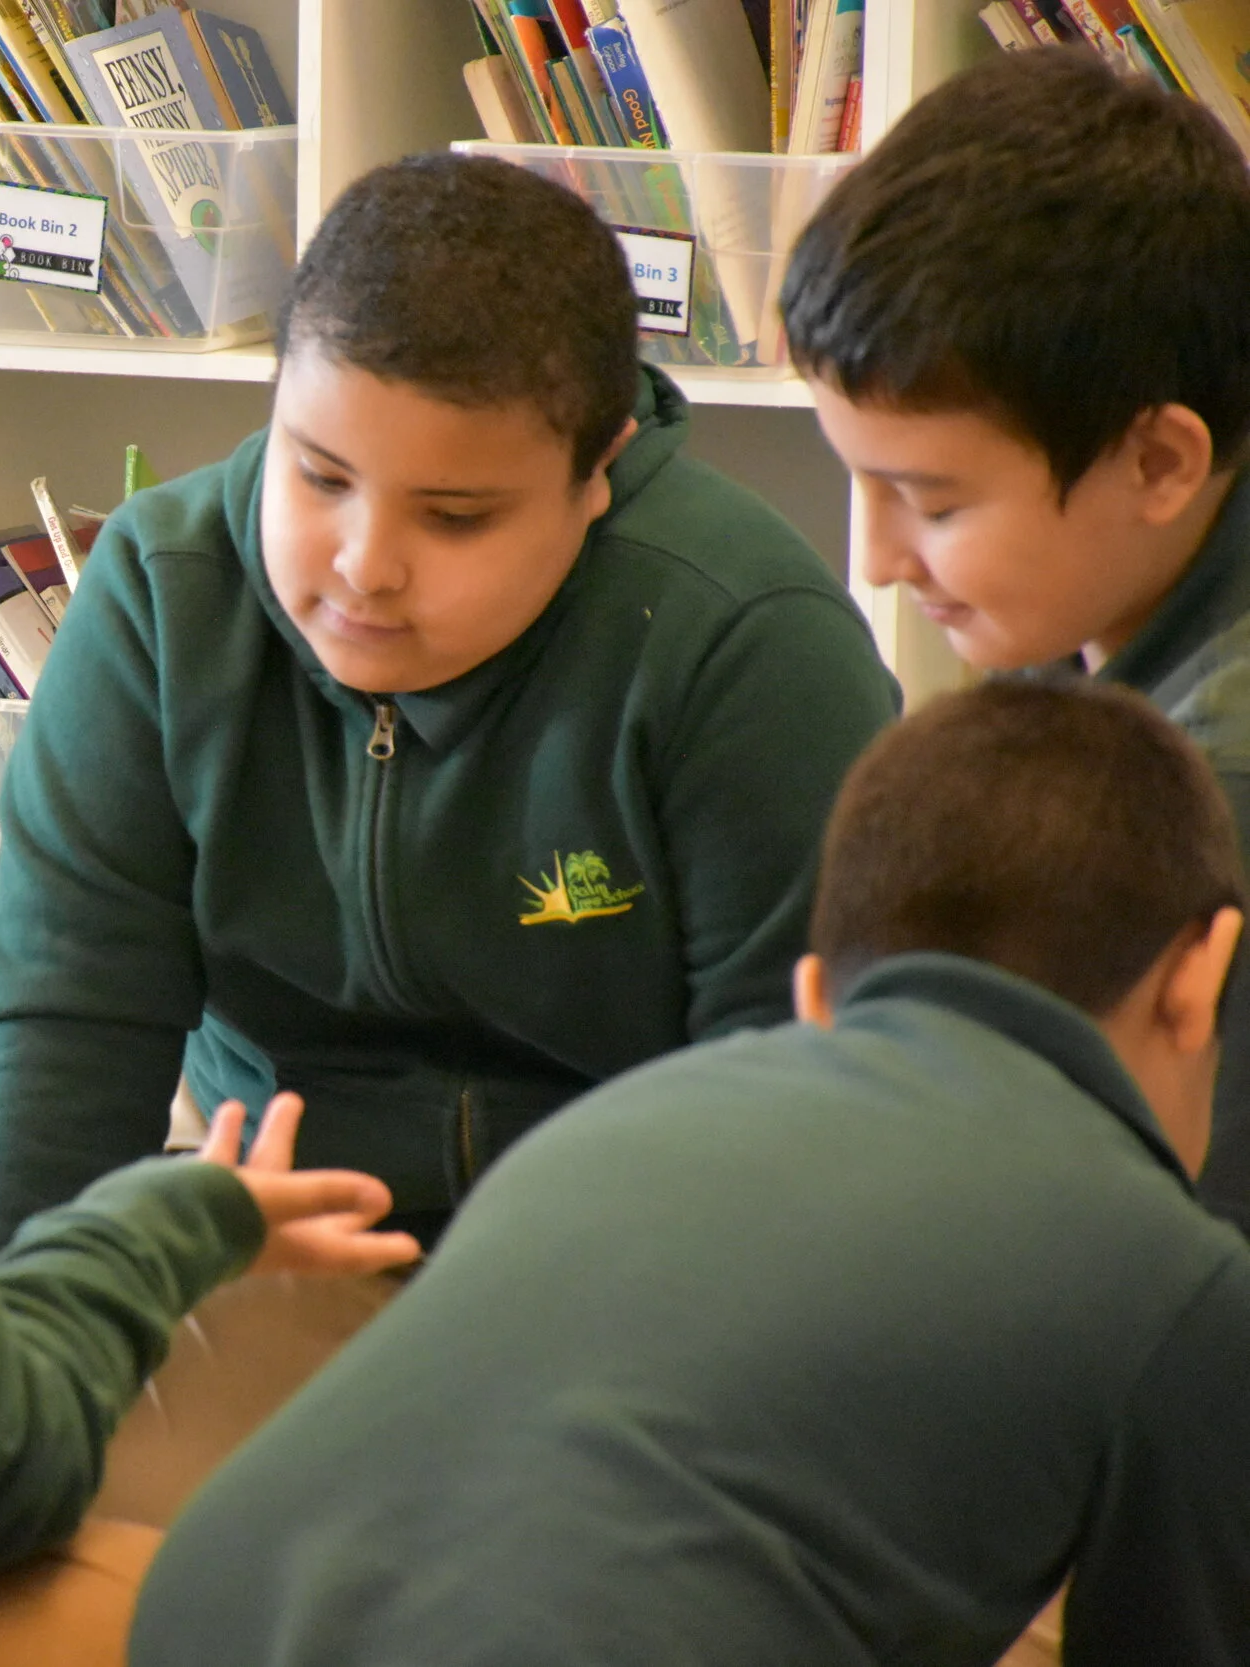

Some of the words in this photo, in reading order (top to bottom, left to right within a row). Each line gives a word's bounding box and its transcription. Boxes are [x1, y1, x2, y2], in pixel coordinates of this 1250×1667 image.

[104, 46, 187, 109] EENSY,
[622, 88, 650, 130] Good
[151, 141, 219, 206] SPIDER
[0, 212, 37, 231] Book
[41, 219, 65, 236] Bin
[68, 223, 78, 238] 2
[20, 252, 53, 267] BOOK
[61, 259, 87, 273] BIN
[634, 262, 662, 281] Bin
[667, 267, 678, 283] 3
[648, 300, 675, 315] BIN
